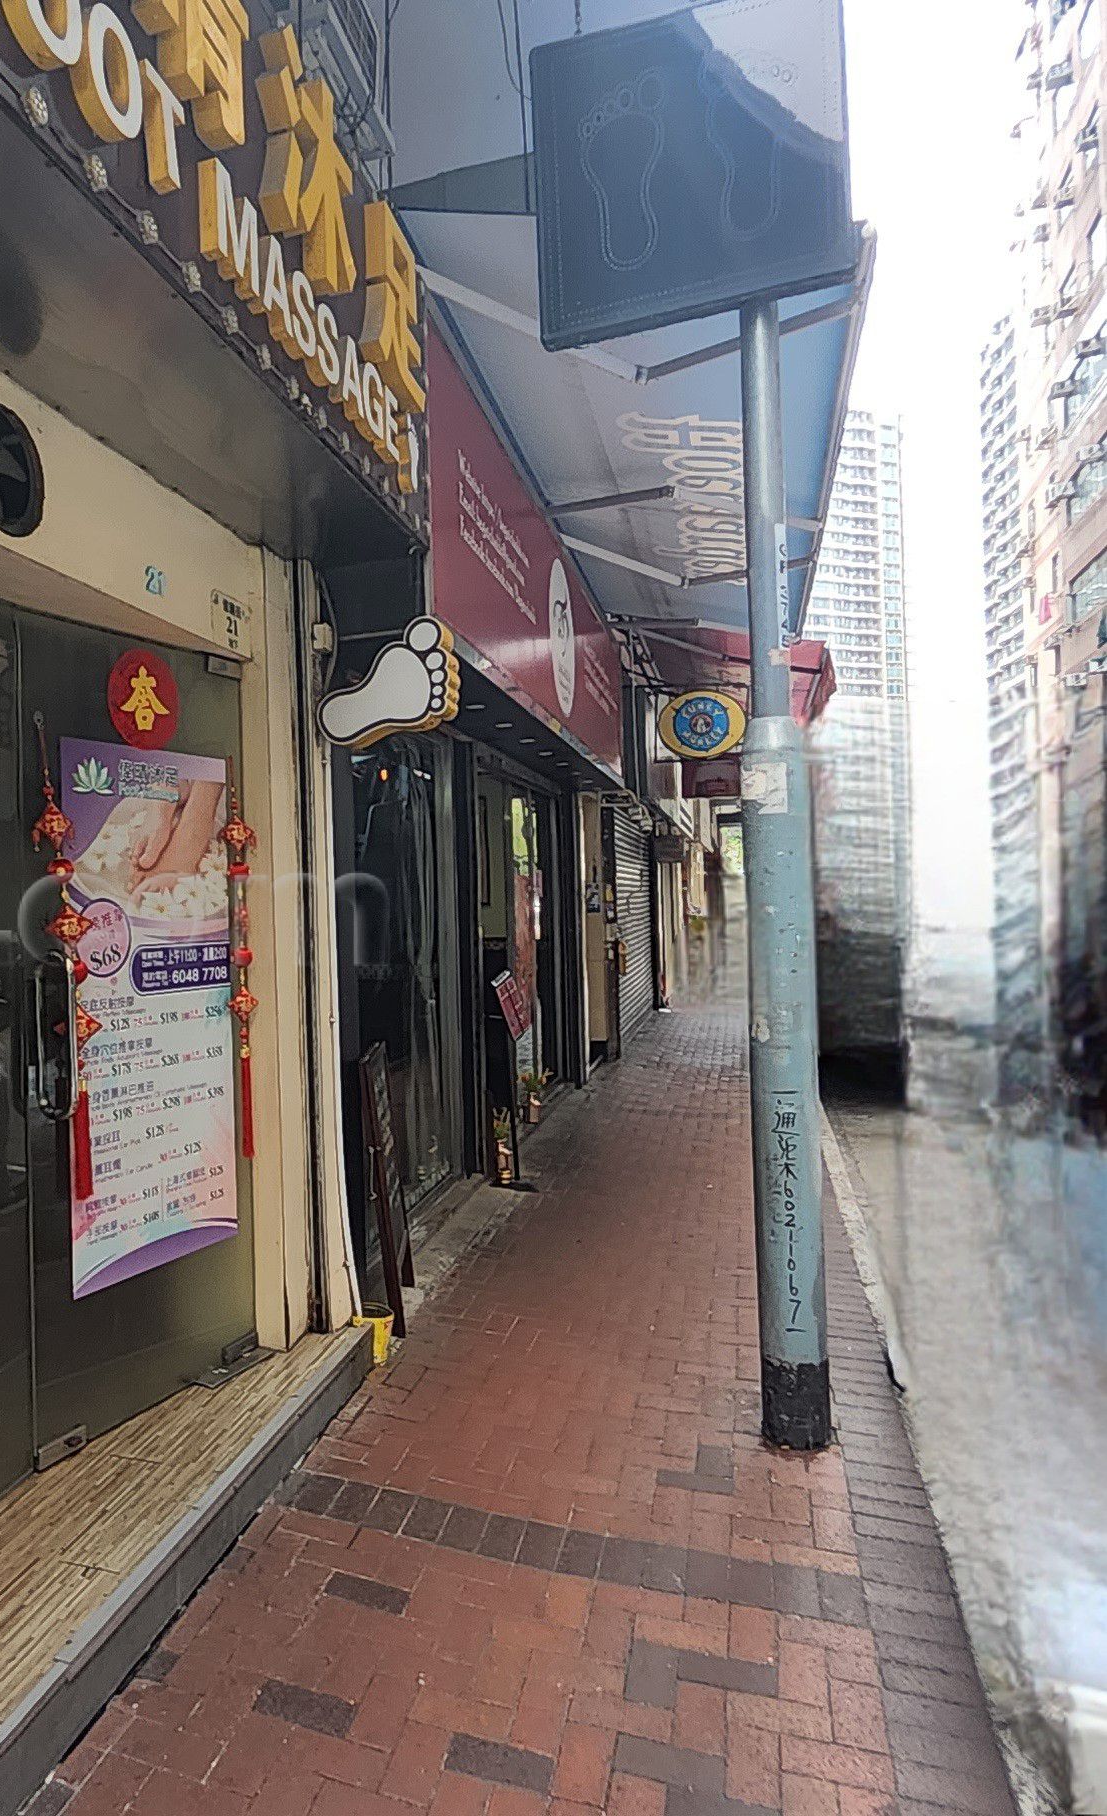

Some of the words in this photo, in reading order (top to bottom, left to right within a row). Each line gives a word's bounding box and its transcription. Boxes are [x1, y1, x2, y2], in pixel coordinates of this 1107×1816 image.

[197, 157, 401, 470] MASSAGE
[172, 968, 199, 984] 6048
[202, 966, 228, 981] 7708
